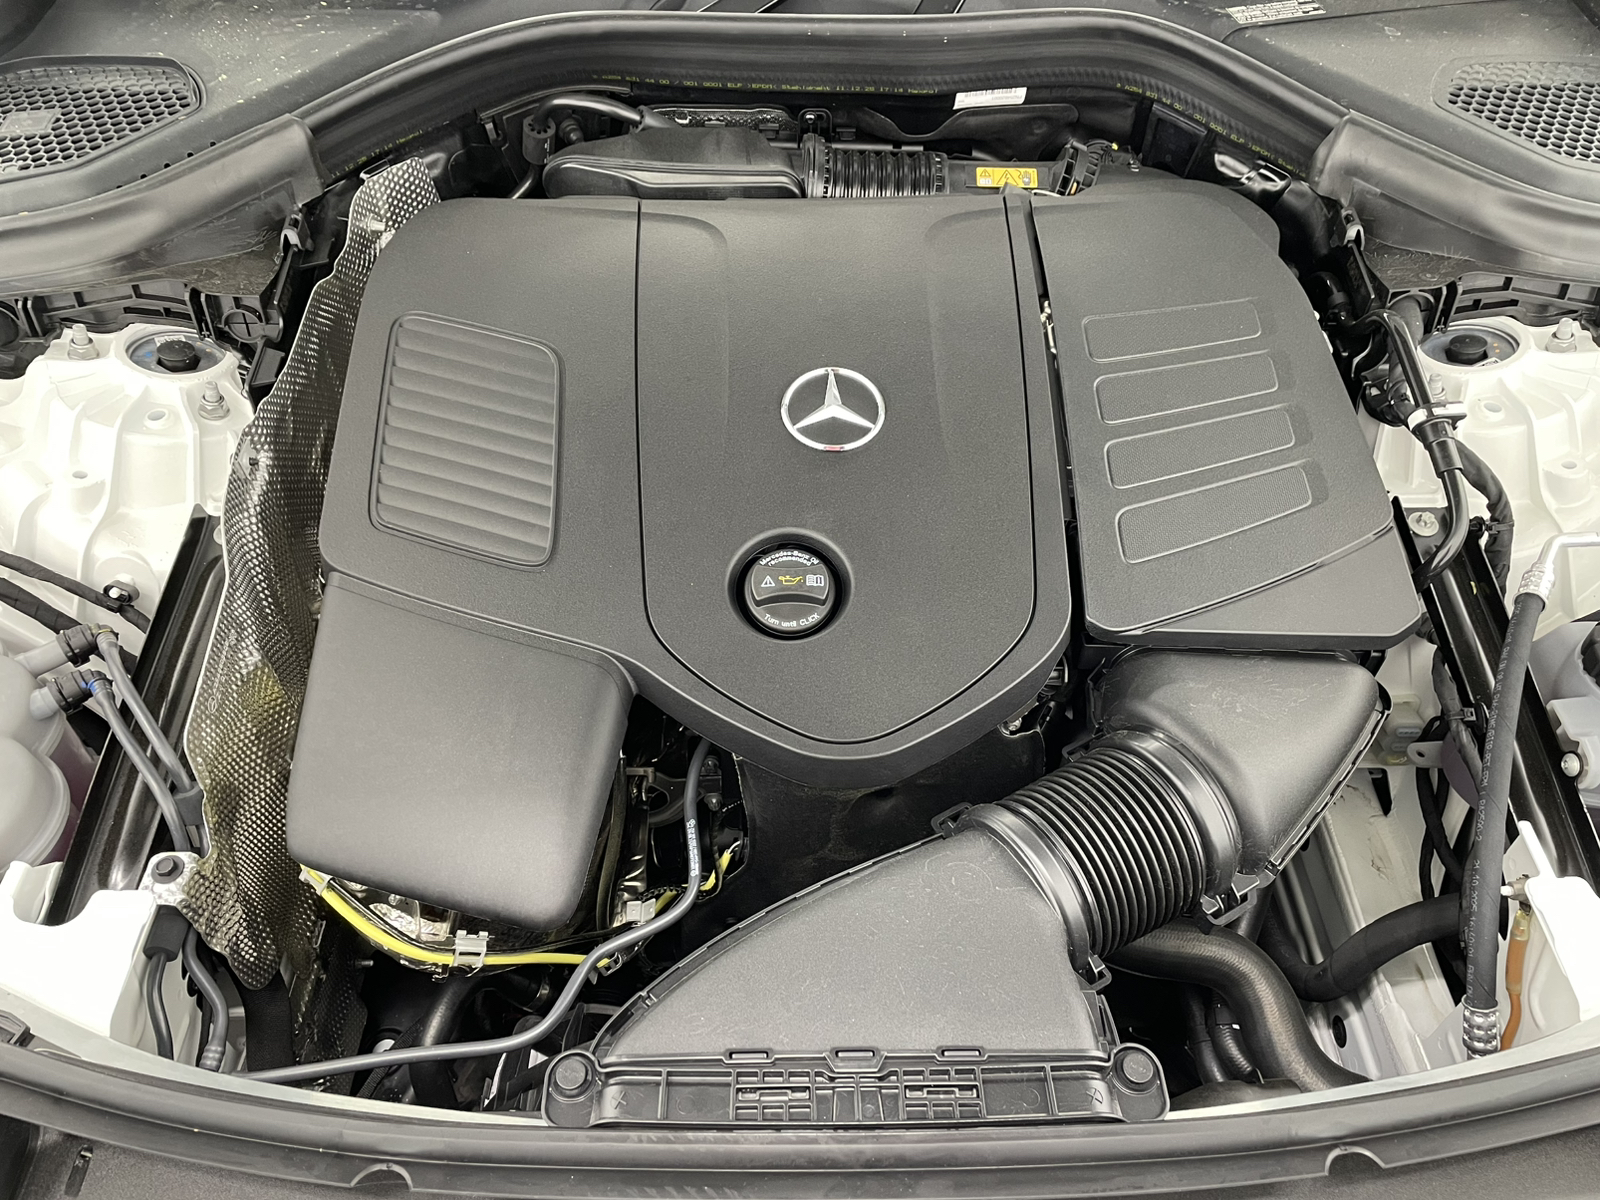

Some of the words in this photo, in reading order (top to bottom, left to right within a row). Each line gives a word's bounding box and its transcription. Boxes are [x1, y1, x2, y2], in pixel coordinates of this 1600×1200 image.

[759, 550, 810, 566] Mercedes-Benz
[767, 555, 812, 567] recommended
[764, 613, 780, 626] Turn
[799, 612, 821, 626] CLICK
